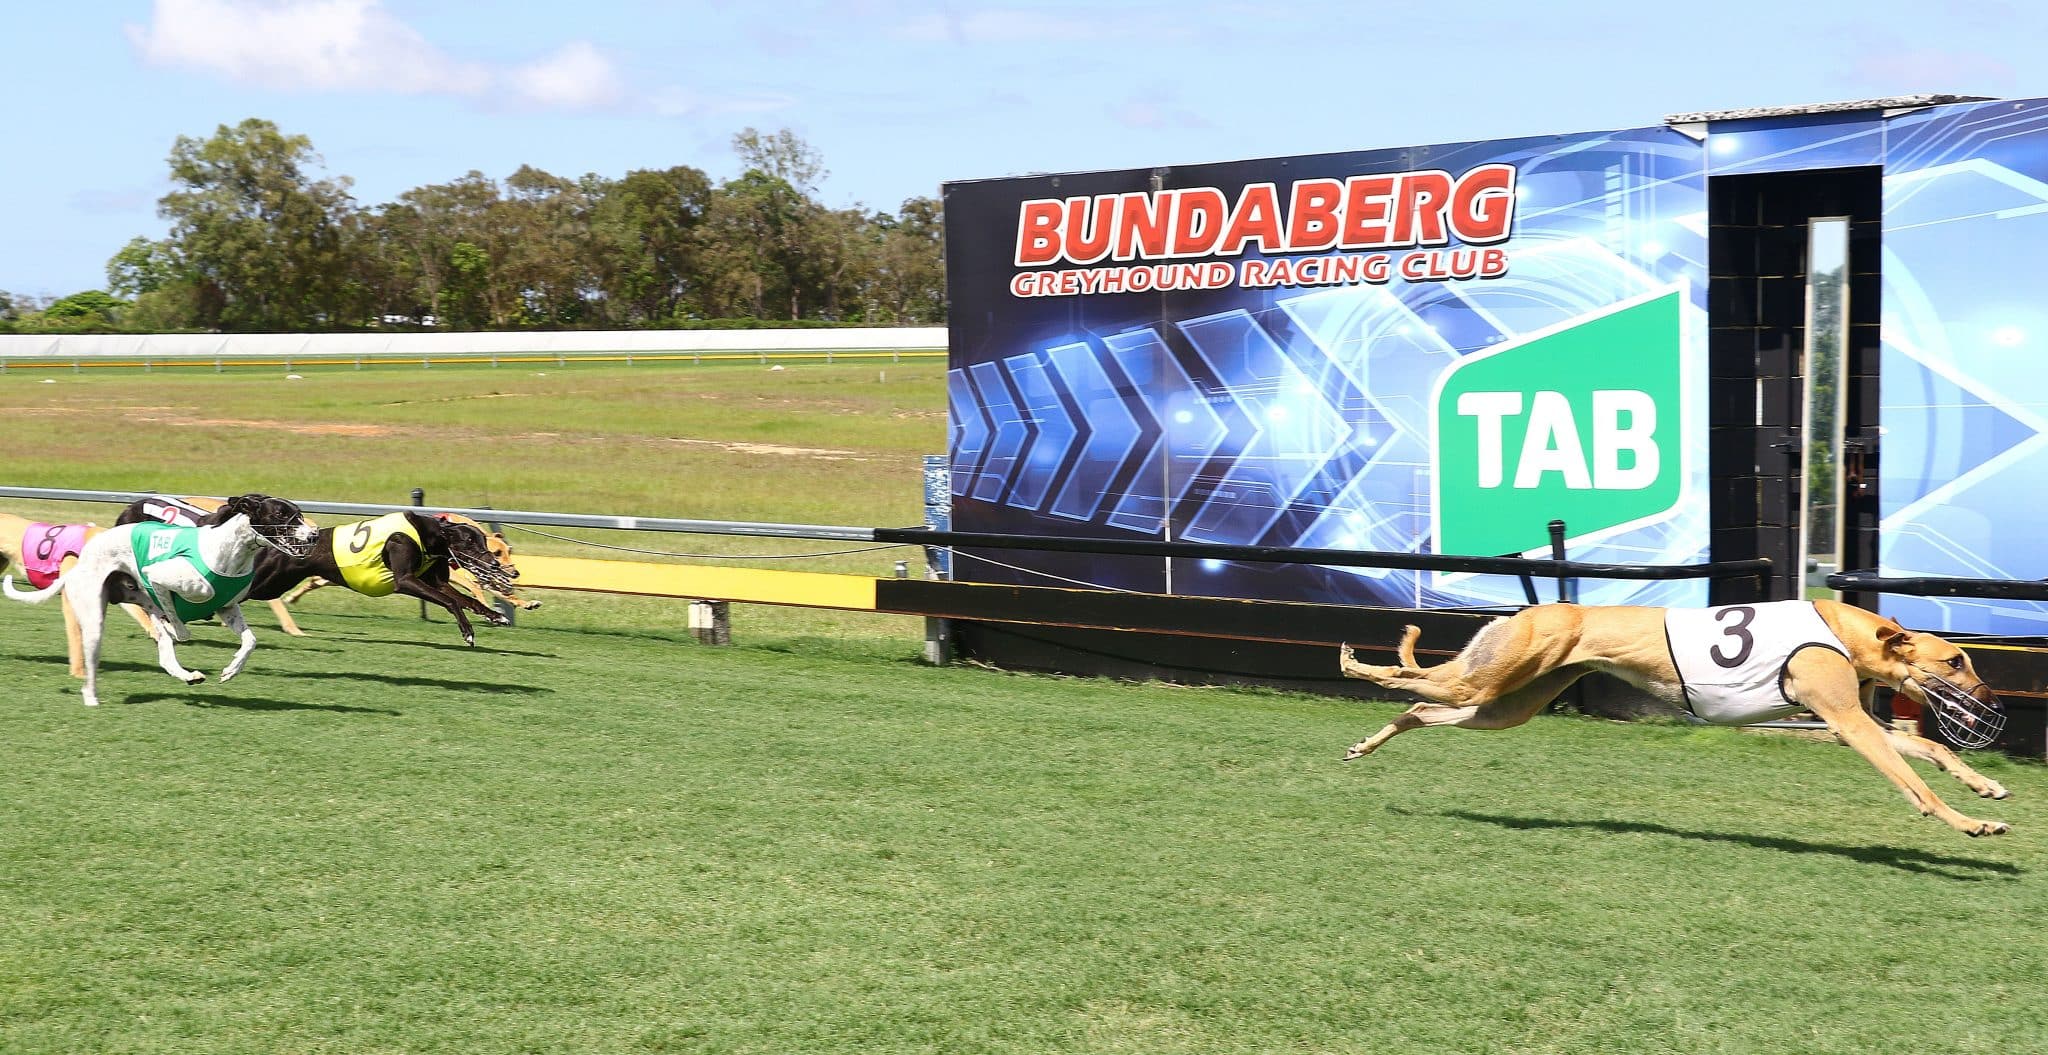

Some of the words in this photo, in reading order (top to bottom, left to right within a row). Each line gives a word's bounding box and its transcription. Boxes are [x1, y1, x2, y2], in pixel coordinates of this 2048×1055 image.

[1015, 165, 1515, 266] BUNDABERG
[1010, 262, 1236, 297] GREYHOUND
[1240, 254, 1393, 287] RACING
[1402, 248, 1509, 281] CLUB
[1457, 389, 1660, 490] TAB
[37, 525, 66, 560] 8
[350, 520, 371, 553] 5
[1711, 606, 1755, 668] 3
